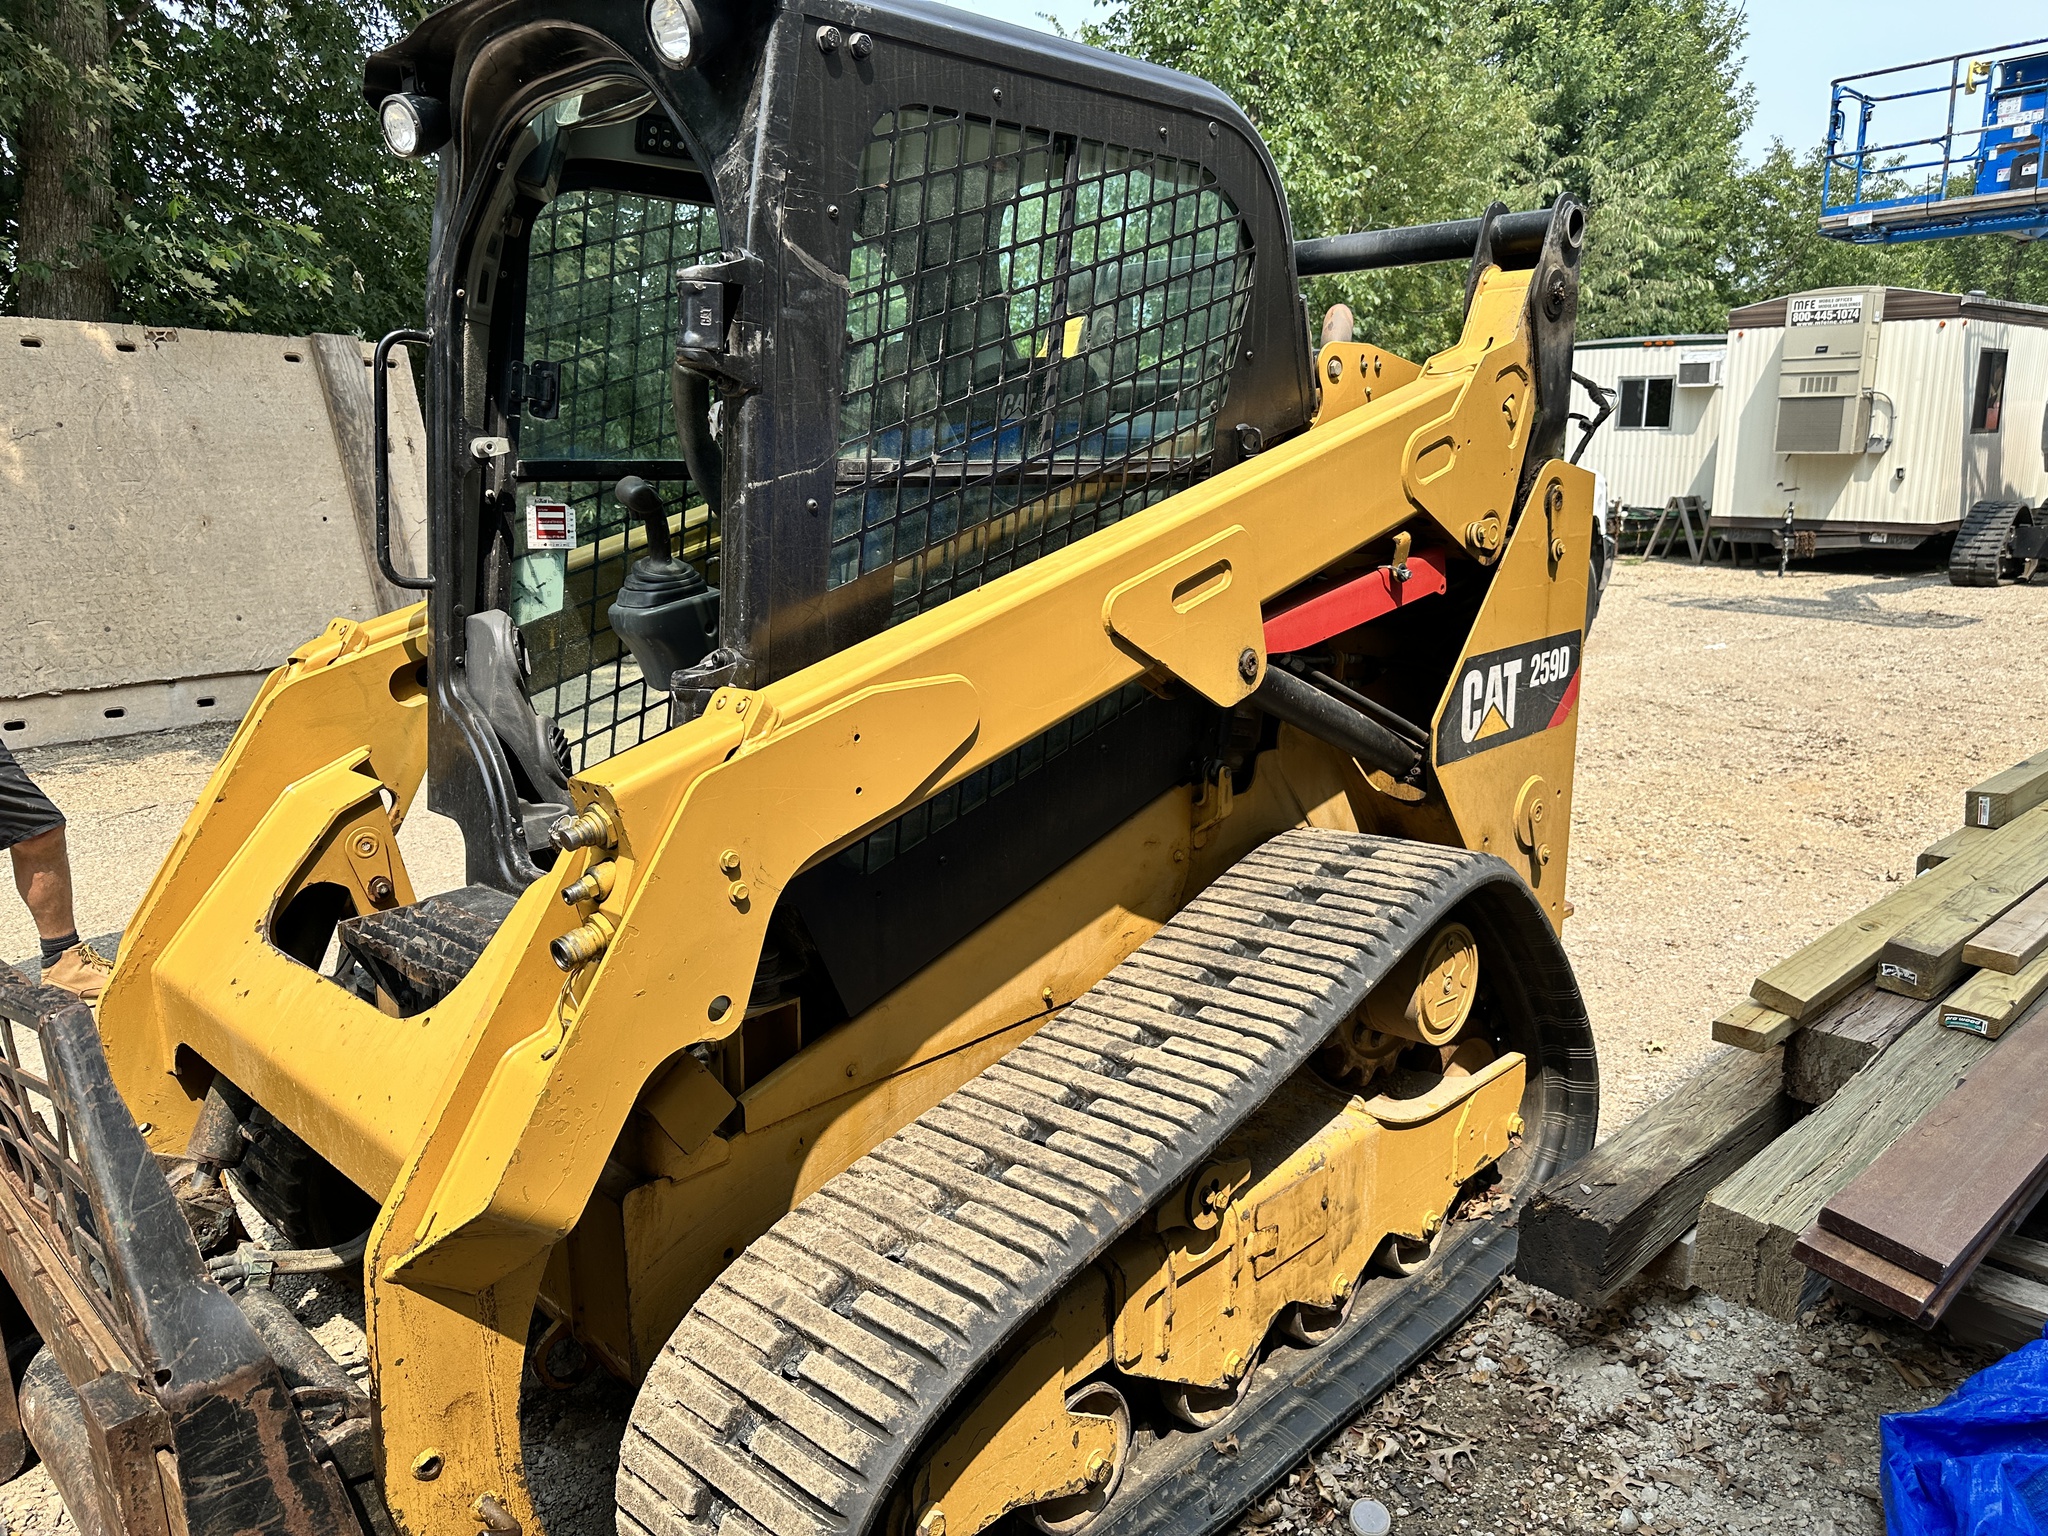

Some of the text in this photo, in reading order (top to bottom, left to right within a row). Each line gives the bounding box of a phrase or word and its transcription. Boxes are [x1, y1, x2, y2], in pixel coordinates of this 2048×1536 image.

[1793, 299, 1816, 310] MFE
[699, 306, 712, 325] CAT
[1792, 309, 1859, 322] 800-445-1074
[1461, 646, 1570, 744] CAT 259D
